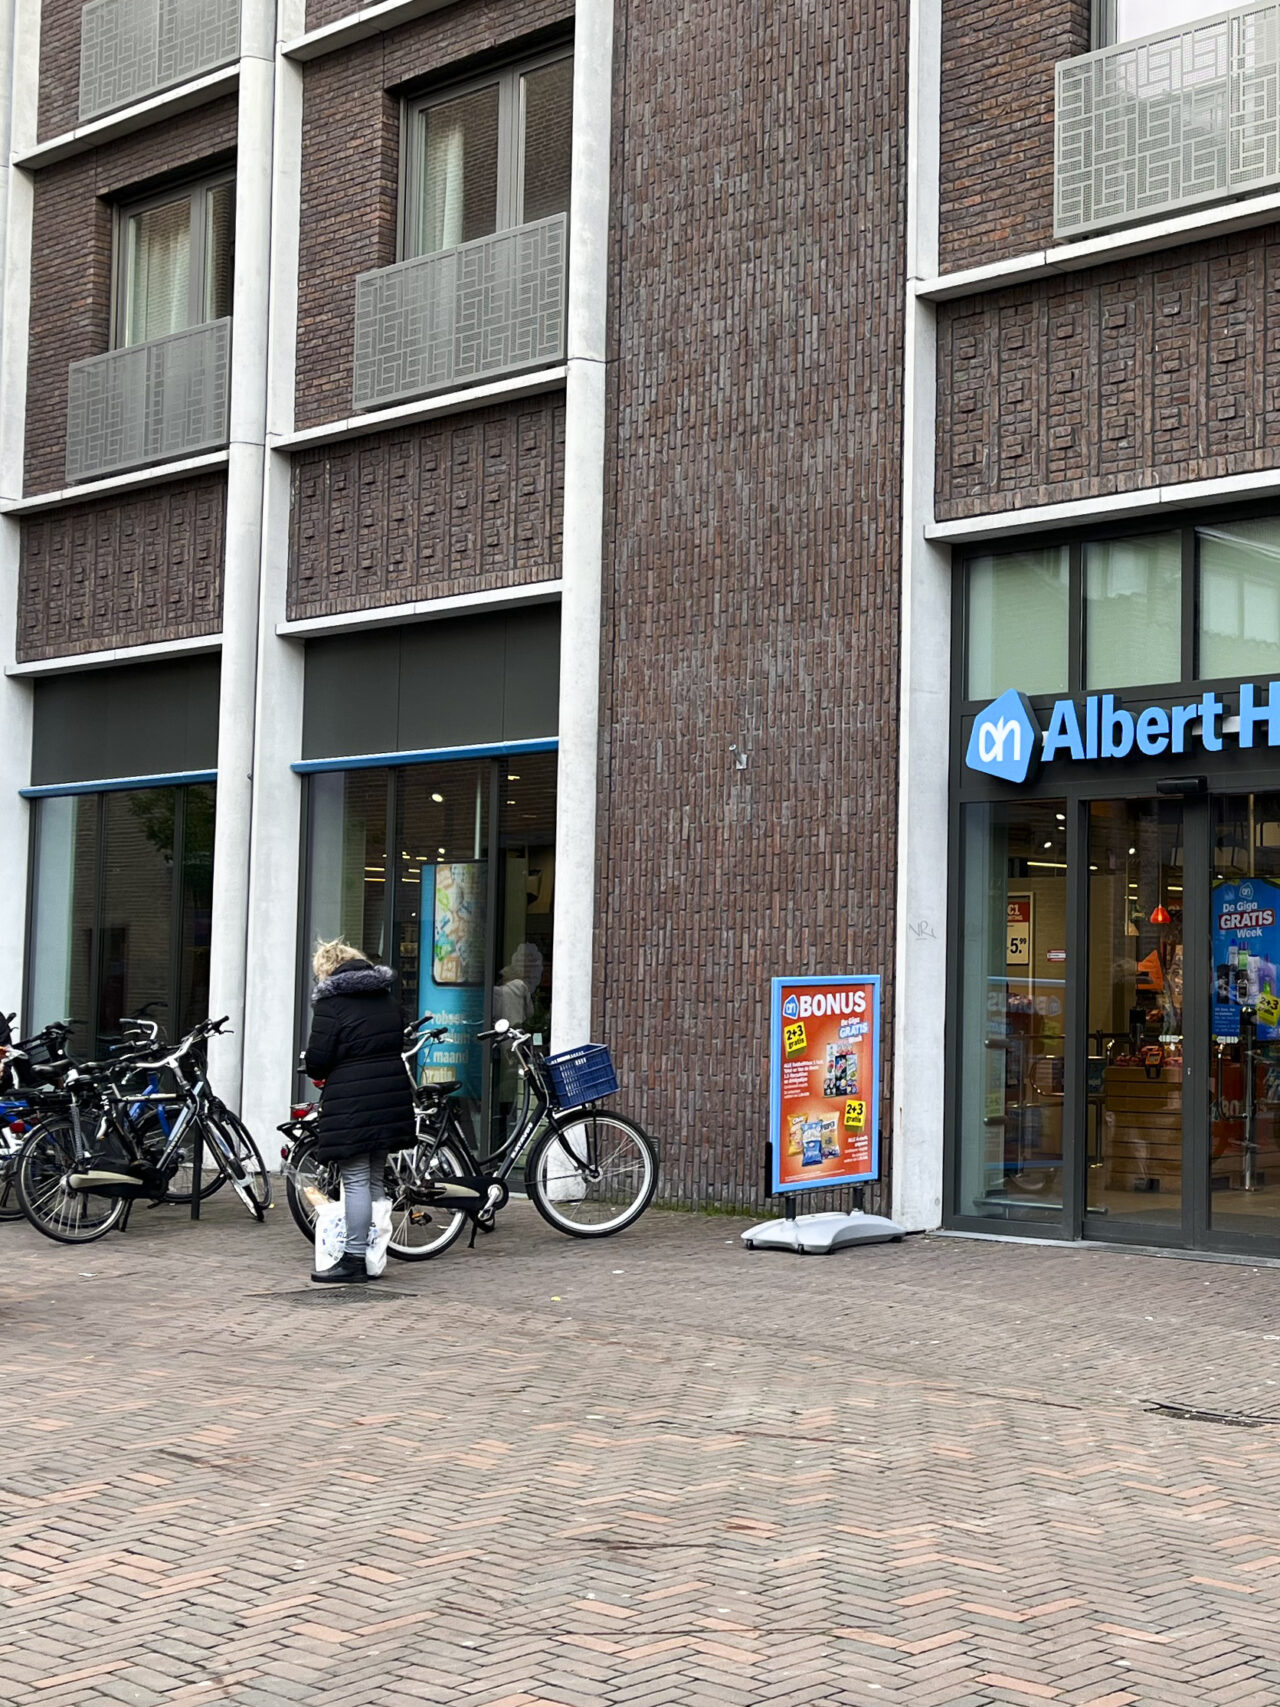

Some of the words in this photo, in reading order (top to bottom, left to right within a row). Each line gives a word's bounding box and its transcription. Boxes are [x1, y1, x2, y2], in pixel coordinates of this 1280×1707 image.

[1041, 693, 1224, 762] Albert
[1223, 903, 1235, 913] De
[1237, 901, 1258, 912] Giga
[1220, 910, 1273, 929] GRATIS
[1237, 927, 1263, 938] Week
[800, 991, 866, 1018] BONUS
[786, 1024, 804, 1041] 2+3
[839, 1022, 869, 1039] GRATIS
[846, 1103, 864, 1116] 2+3
